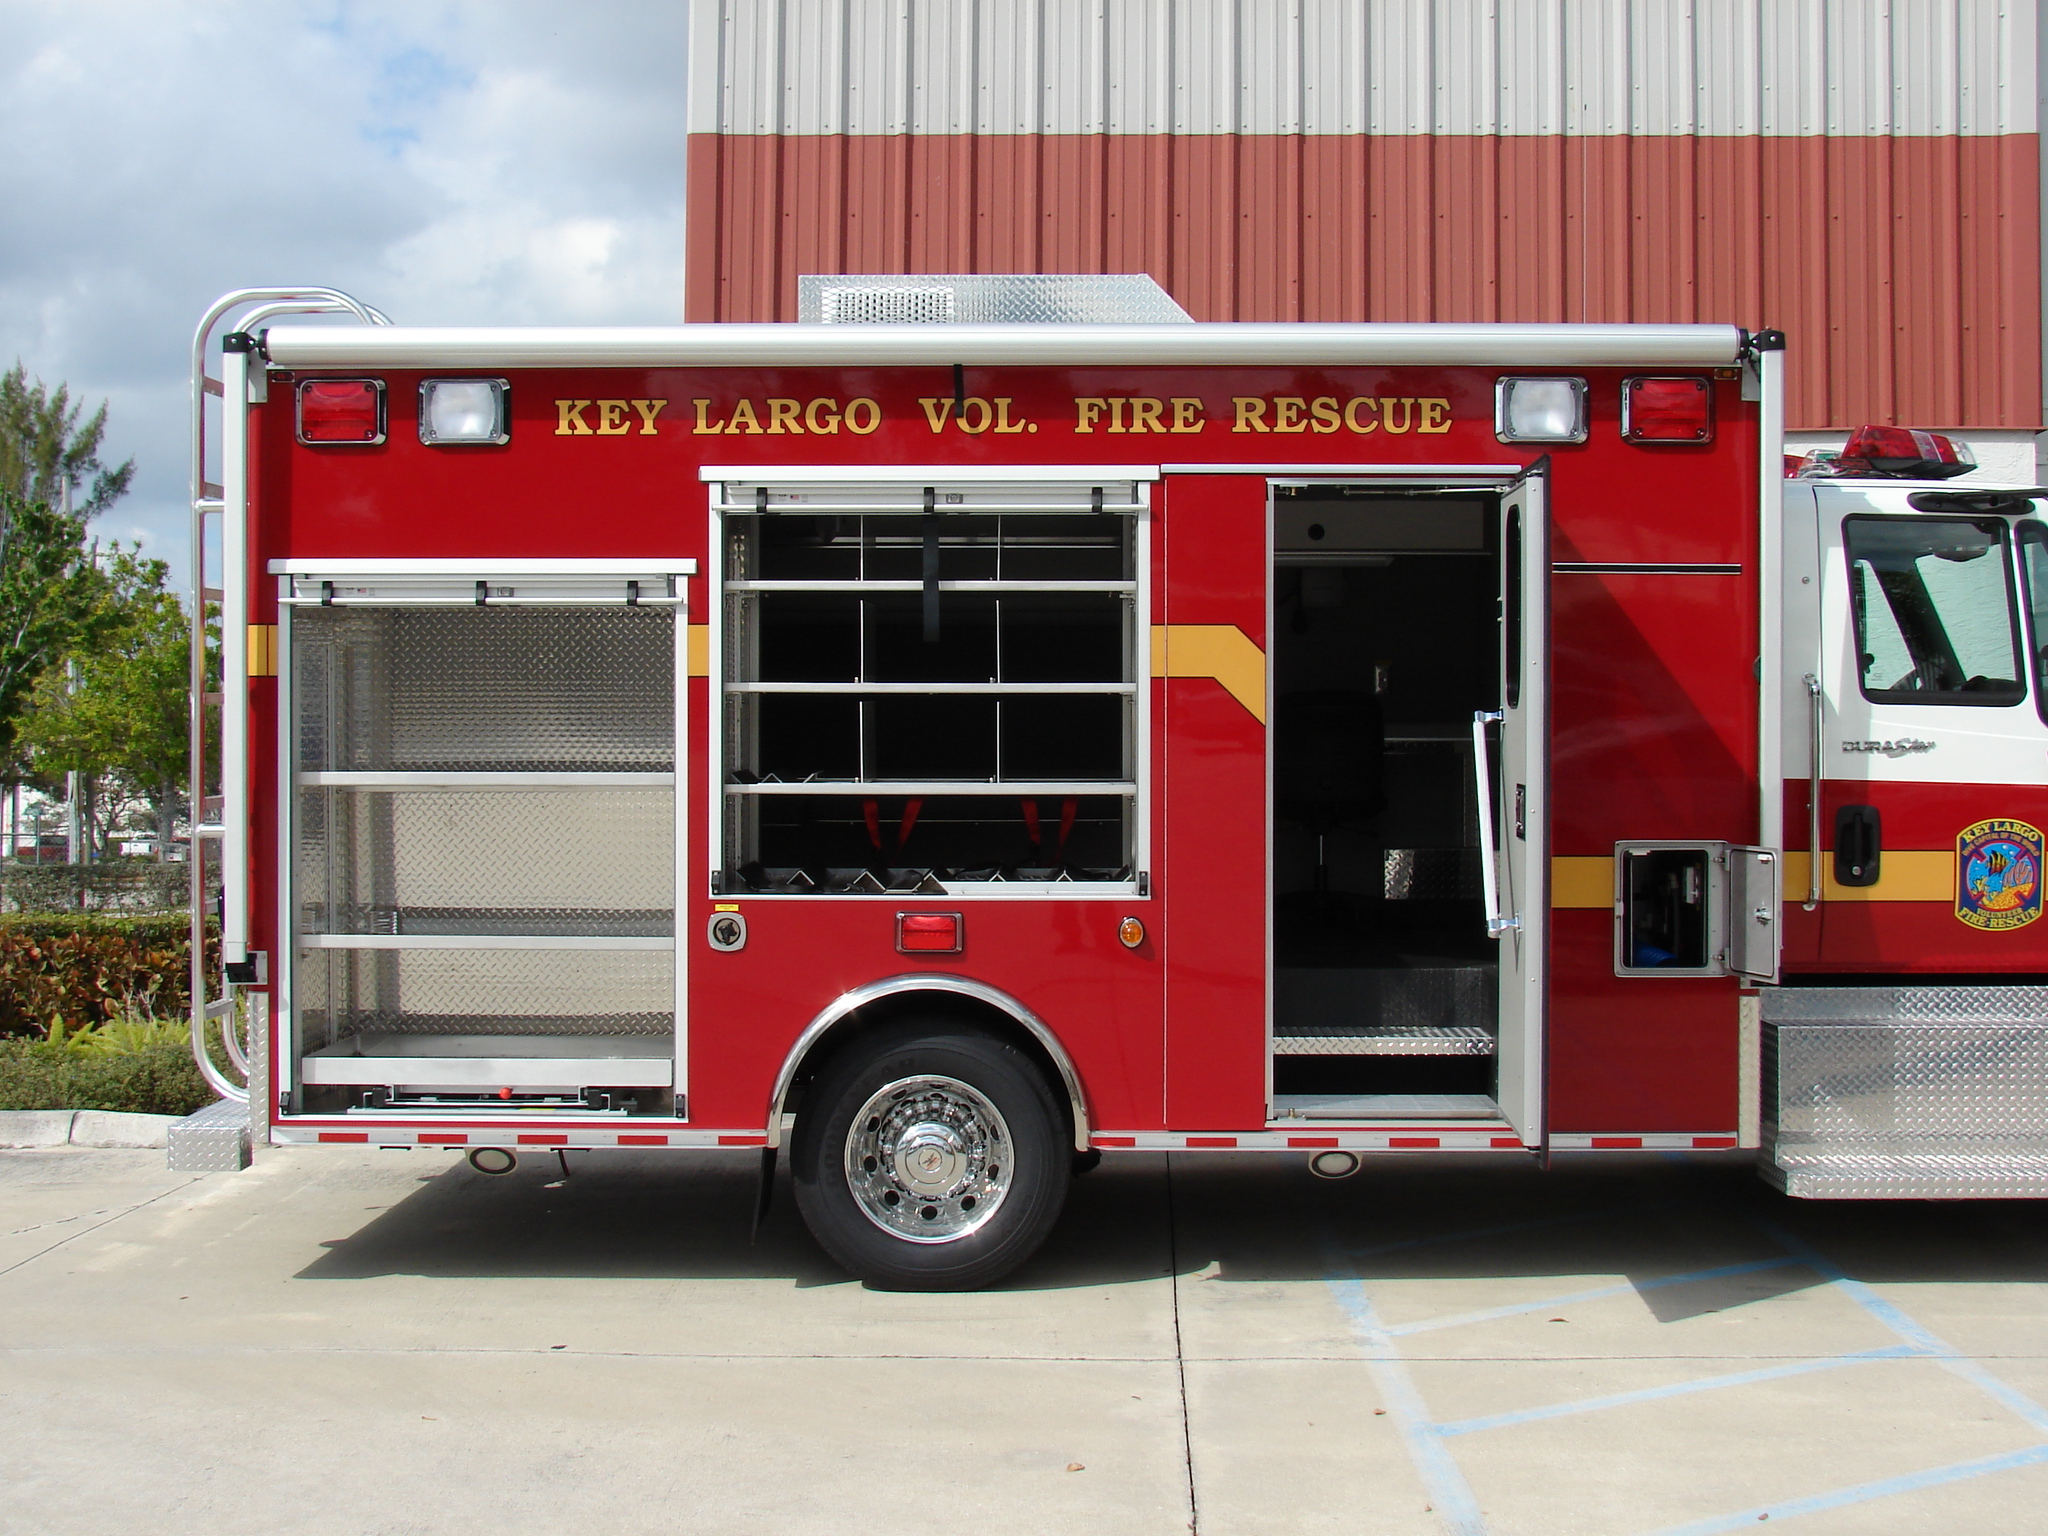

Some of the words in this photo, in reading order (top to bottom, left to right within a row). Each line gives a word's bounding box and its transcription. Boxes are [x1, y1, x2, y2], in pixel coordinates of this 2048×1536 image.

[554, 398, 669, 437] KEY
[691, 398, 882, 436] LARGO
[917, 397, 1039, 435] VOL.
[1073, 397, 1206, 435] FIRE
[1230, 397, 1452, 435] RESCUE
[1962, 822, 1991, 843] KEY
[1993, 822, 2039, 842] LARGO
[1977, 907, 2022, 918] VOLUNTEER
